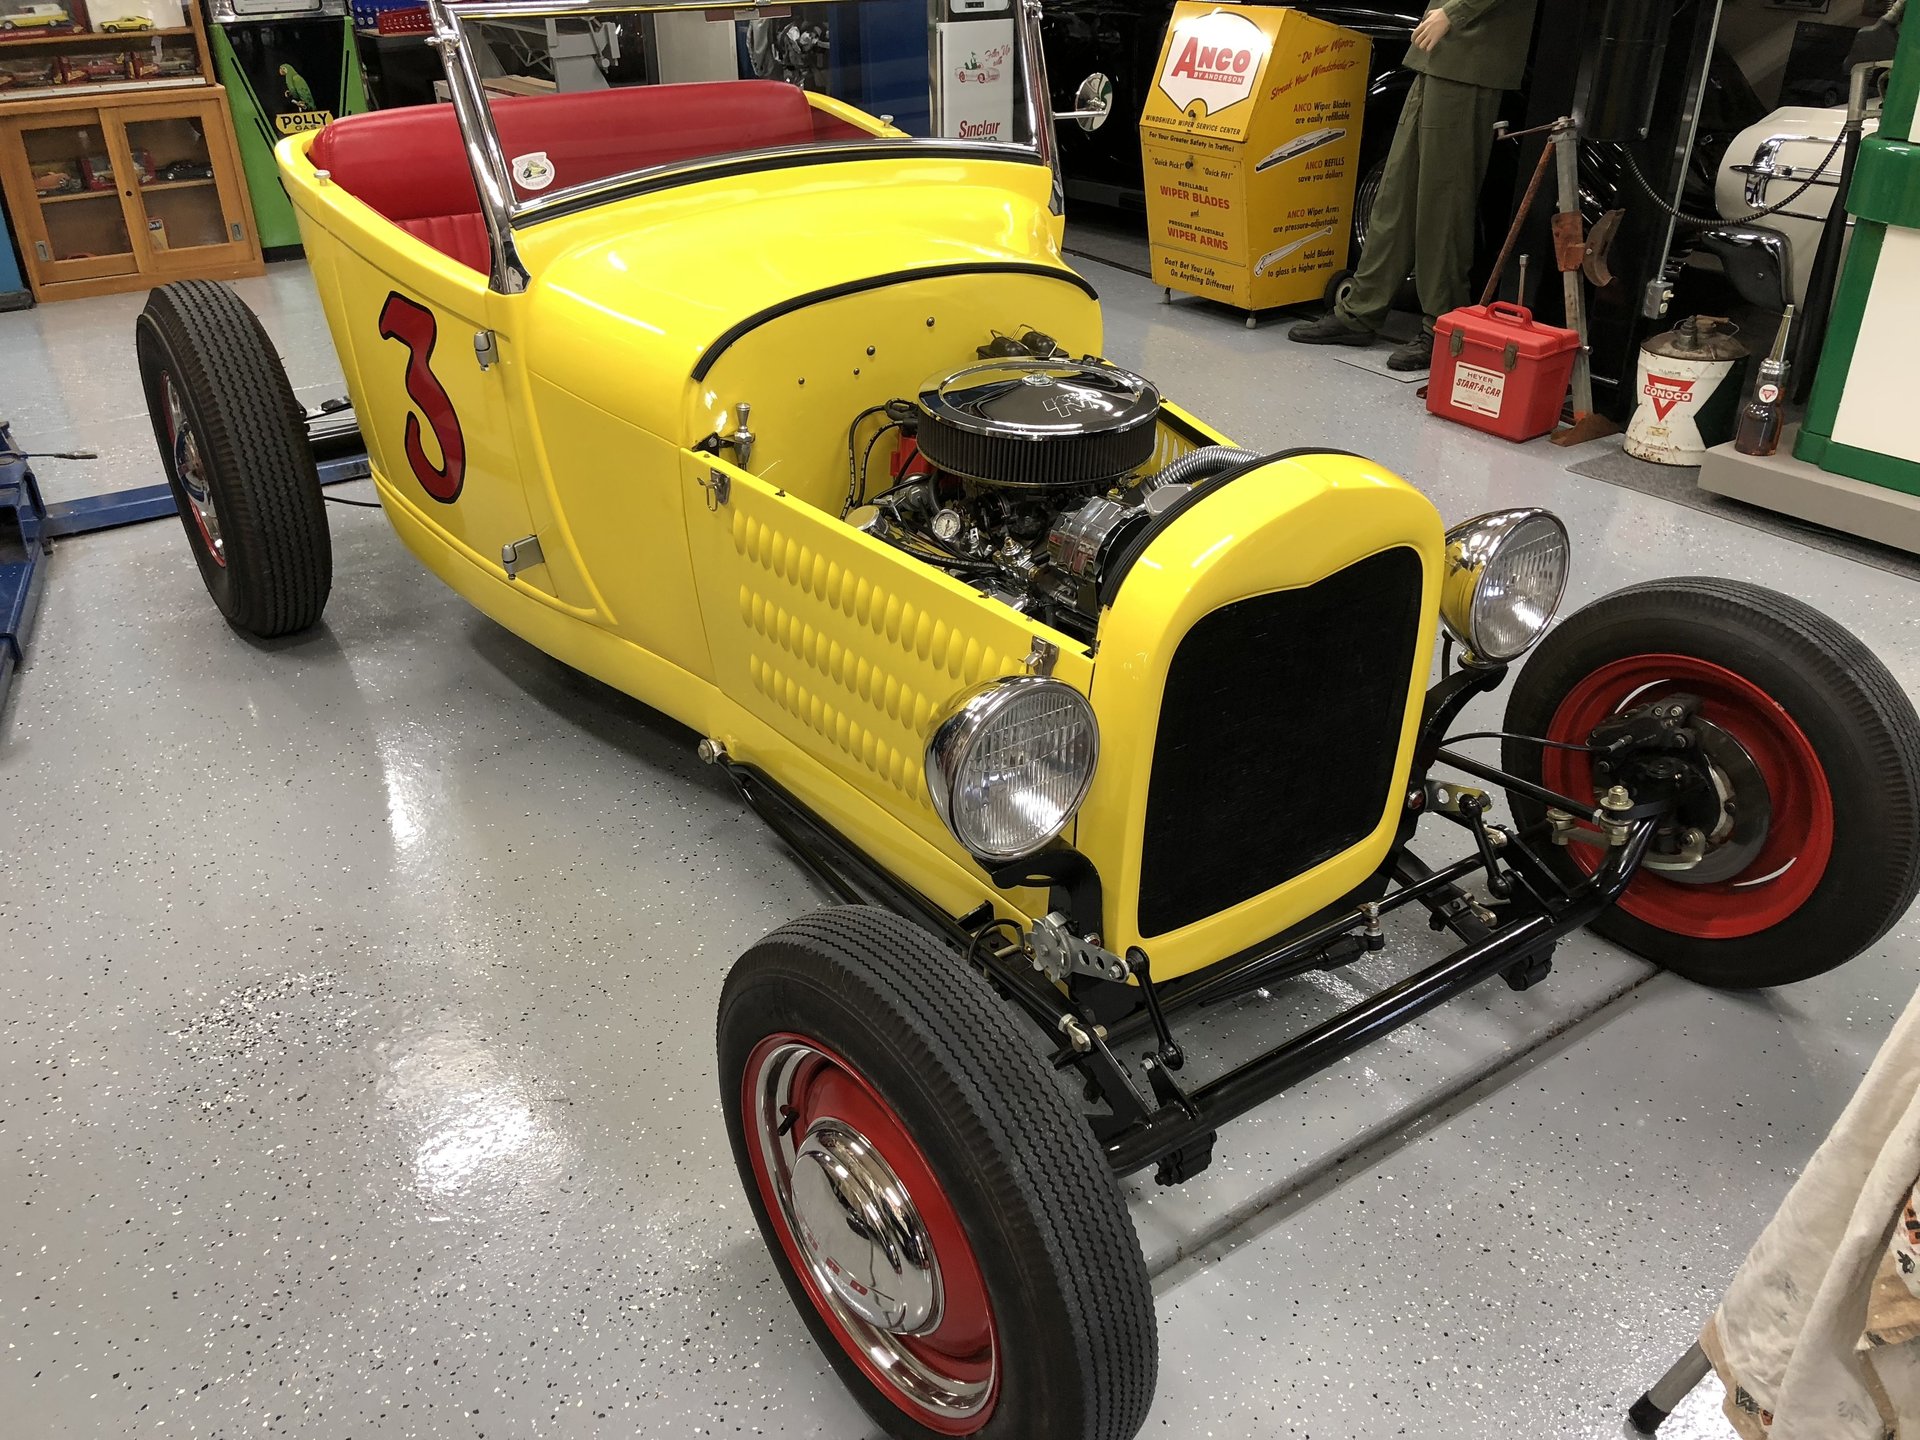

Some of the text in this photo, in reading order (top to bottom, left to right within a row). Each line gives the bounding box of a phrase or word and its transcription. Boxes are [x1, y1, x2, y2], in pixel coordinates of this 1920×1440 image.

[1314, 45, 1328, 56] Your
[1331, 38, 1356, 53] Wipers
[1171, 36, 1251, 76] ANCO
[1204, 74, 1242, 84] ANDERSON
[1271, 79, 1293, 100] Streak
[1295, 73, 1309, 86] Your
[1294, 99, 1351, 112] ANCO Wiper Blades
[281, 113, 327, 129] POLLY
[1146, 115, 1241, 135] WINDSHIELD WIPER SERVICE CENTER
[1307, 113, 1323, 124] easily
[1326, 111, 1350, 121] refillable
[959, 120, 1000, 138] Sinclair
[1170, 135, 1189, 144] Greater
[1190, 139, 1207, 148] Safety
[1215, 144, 1235, 152] Traffic!
[1305, 157, 1344, 170] ANCO REFILLS
[1298, 169, 1343, 183] save you dollars
[1178, 181, 1208, 192] REFILLABLE
[1160, 186, 1230, 209] WIPER BLADES
[1190, 209, 1199, 217] and
[1287, 206, 1340, 219] ANCO Wiper Arms
[1169, 220, 1224, 237] PRESSURE ADJUSTABLE
[1285, 216, 1338, 234] pressure-adjustable
[1168, 227, 1228, 250] WIPER ARMS
[1303, 248, 1334, 260] hold Blades
[1180, 261, 1189, 270] Bet
[1191, 263, 1203, 274] Your
[1204, 267, 1215, 277] Life
[1275, 267, 1289, 278] glass
[1298, 263, 1315, 273] higher
[1318, 261, 1333, 269] winds
[1171, 269, 1235, 292] On Anything Different!
[1468, 372, 1493, 384] HEYER
[379, 290, 466, 504] 3
[1644, 386, 1692, 401] CONOCO
